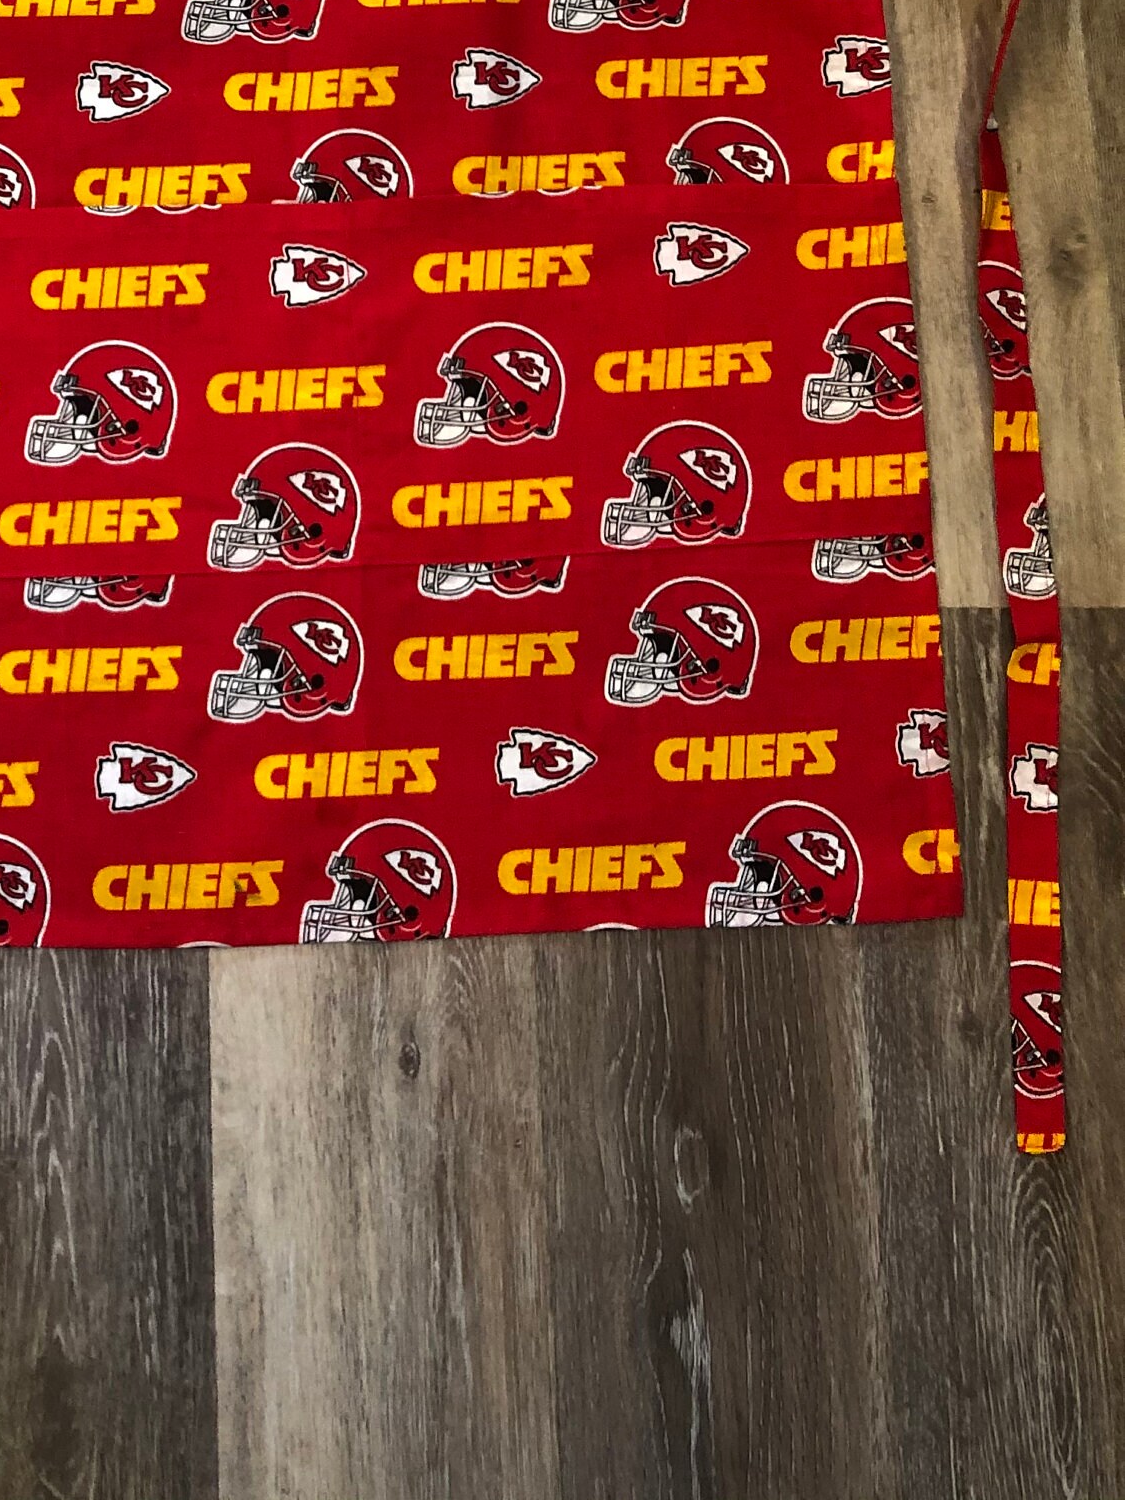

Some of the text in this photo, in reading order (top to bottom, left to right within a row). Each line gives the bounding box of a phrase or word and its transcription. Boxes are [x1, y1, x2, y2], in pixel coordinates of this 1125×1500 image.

[98, 75, 148, 108] KC
[223, 66, 399, 111] CHIEFS
[474, 61, 520, 96] KC
[595, 55, 768, 99] CHIEFS
[74, 163, 251, 208] CHIEFS
[452, 151, 626, 195] CHIEFS
[292, 258, 344, 292] KC
[412, 243, 593, 293] CHIEFS
[676, 235, 728, 270] KC
[30, 263, 209, 310] CHIEFS
[206, 365, 386, 414] CHIEFS
[594, 341, 772, 393] CHIEFS
[392, 476, 573, 528] CHIEFS
[393, 631, 579, 681] CHIEFS
[789, 614, 944, 663] CHIEF
[119, 757, 173, 795] KC
[254, 747, 440, 799] CHIEFS
[518, 742, 573, 779] KC
[654, 729, 838, 782] CHIEFS
[92, 860, 284, 911] CHIEFS
[497, 841, 686, 895] CHIEFS
